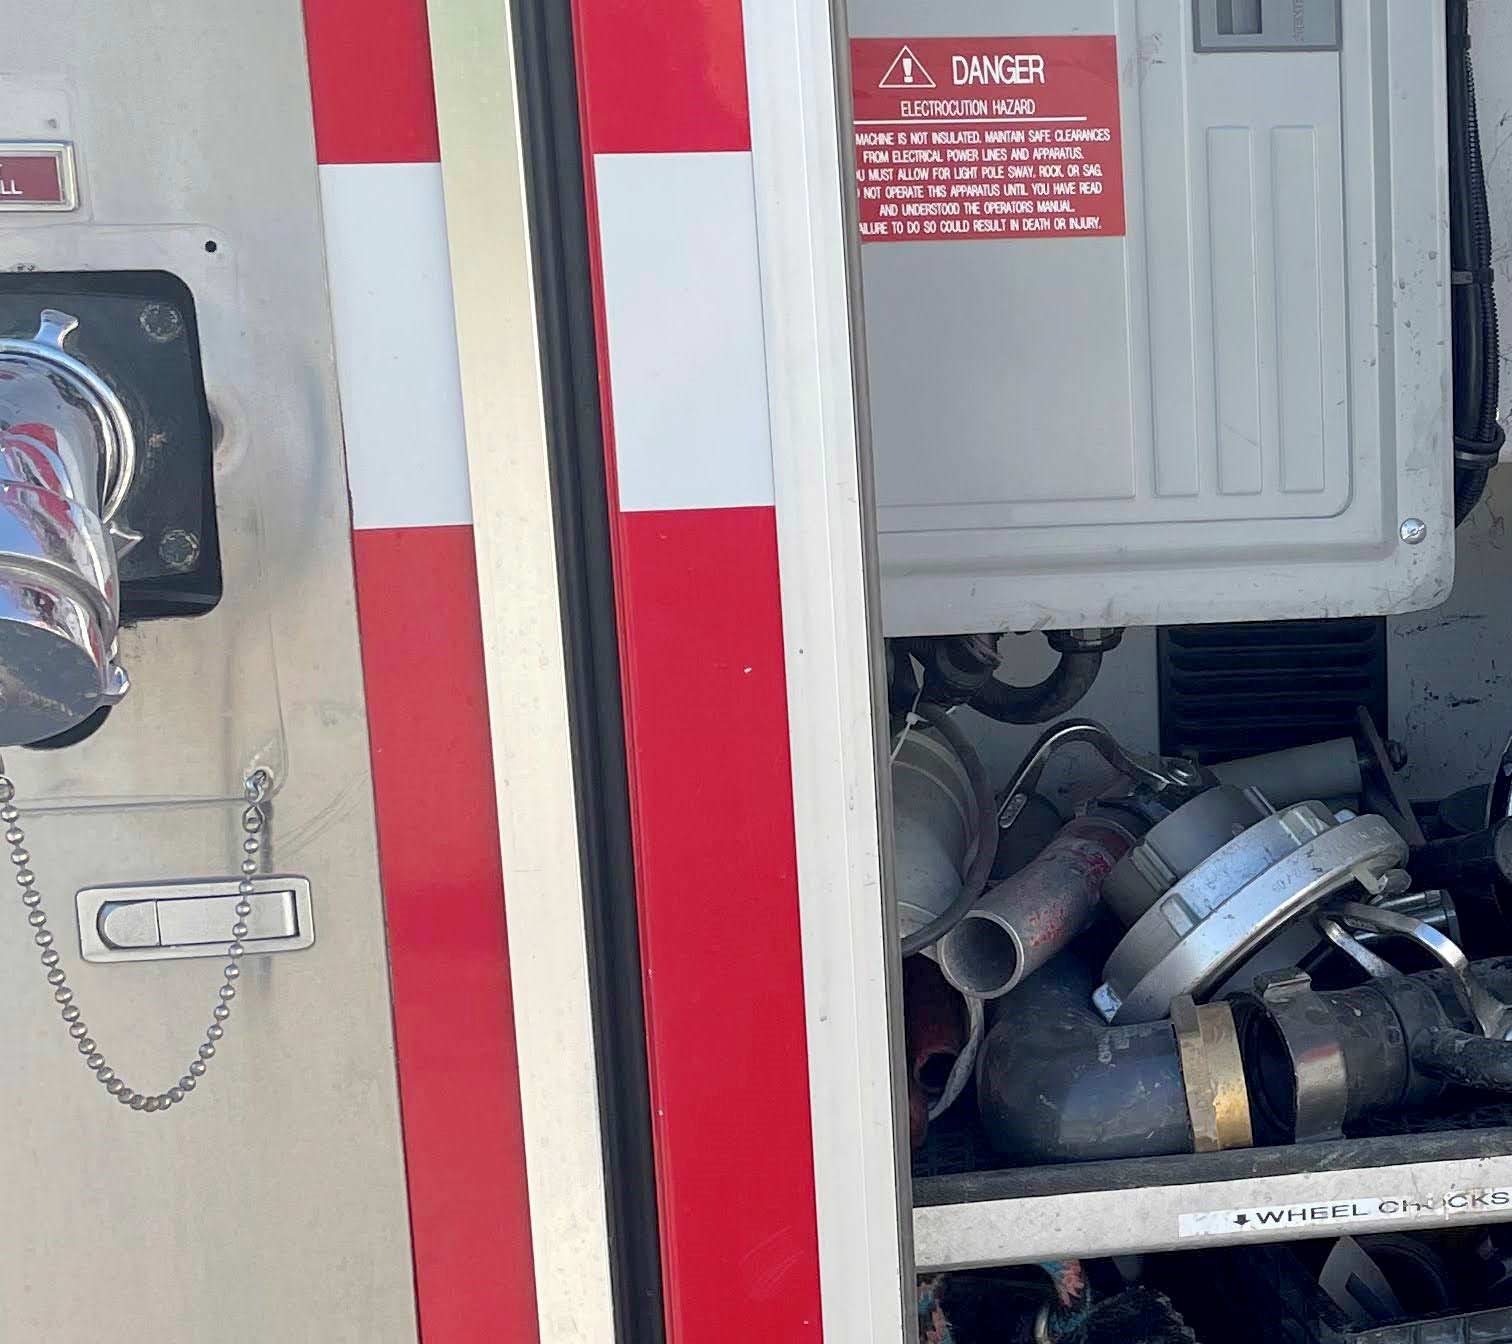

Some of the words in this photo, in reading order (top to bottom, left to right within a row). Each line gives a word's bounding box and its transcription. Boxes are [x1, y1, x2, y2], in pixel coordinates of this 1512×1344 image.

[952, 55, 1046, 86] DANGER
[900, 100, 989, 118] ELECTROCUTION
[992, 98, 1036, 116] HAZARD
[855, 132, 895, 146] MACHINE
[897, 132, 907, 145] IS
[910, 131, 928, 145] NOT
[984, 130, 1025, 144] MAINTAIN
[1028, 129, 1052, 143] SAFE
[1054, 128, 1111, 142] CLEARANCES
[862, 150, 889, 163] FROM
[892, 149, 944, 163] ELECTRICAL
[947, 148, 980, 162] POWER
[981, 148, 1008, 162] LINES
[1010, 147, 1029, 161] AND
[868, 168, 894, 182] MUST
[897, 167, 929, 181] ALLOW
[932, 167, 951, 180] FOR
[953, 166, 978, 180] LIGHT
[981, 165, 1005, 179] POLE
[1067, 164, 1080, 177] OR
[863, 186, 881, 200] NOT
[885, 185, 925, 199] OPERATE
[927, 185, 947, 198] THIS
[950, 183, 1000, 198] APPARATUS
[1003, 183, 1029, 196] UNTIL
[1031, 182, 1050, 196] YOU
[1053, 182, 1076, 195] HAVE
[1079, 181, 1103, 195] READ
[879, 203, 899, 217] AND
[901, 202, 960, 217] UNDERSTOOD
[963, 202, 980, 215] THE
[983, 201, 1034, 215] OPERATORS
[858, 221, 889, 235] AILURE
[891, 221, 904, 234] TO
[906, 221, 920, 234] DO
[923, 220, 937, 234] SO
[940, 219, 970, 233] COULD
[972, 218, 1006, 232] RESULT
[1009, 218, 1019, 232] IN
[1022, 217, 1051, 231] DEATH
[1053, 217, 1066, 231] OR
[1256, 1203, 1369, 1224] WHEEL
